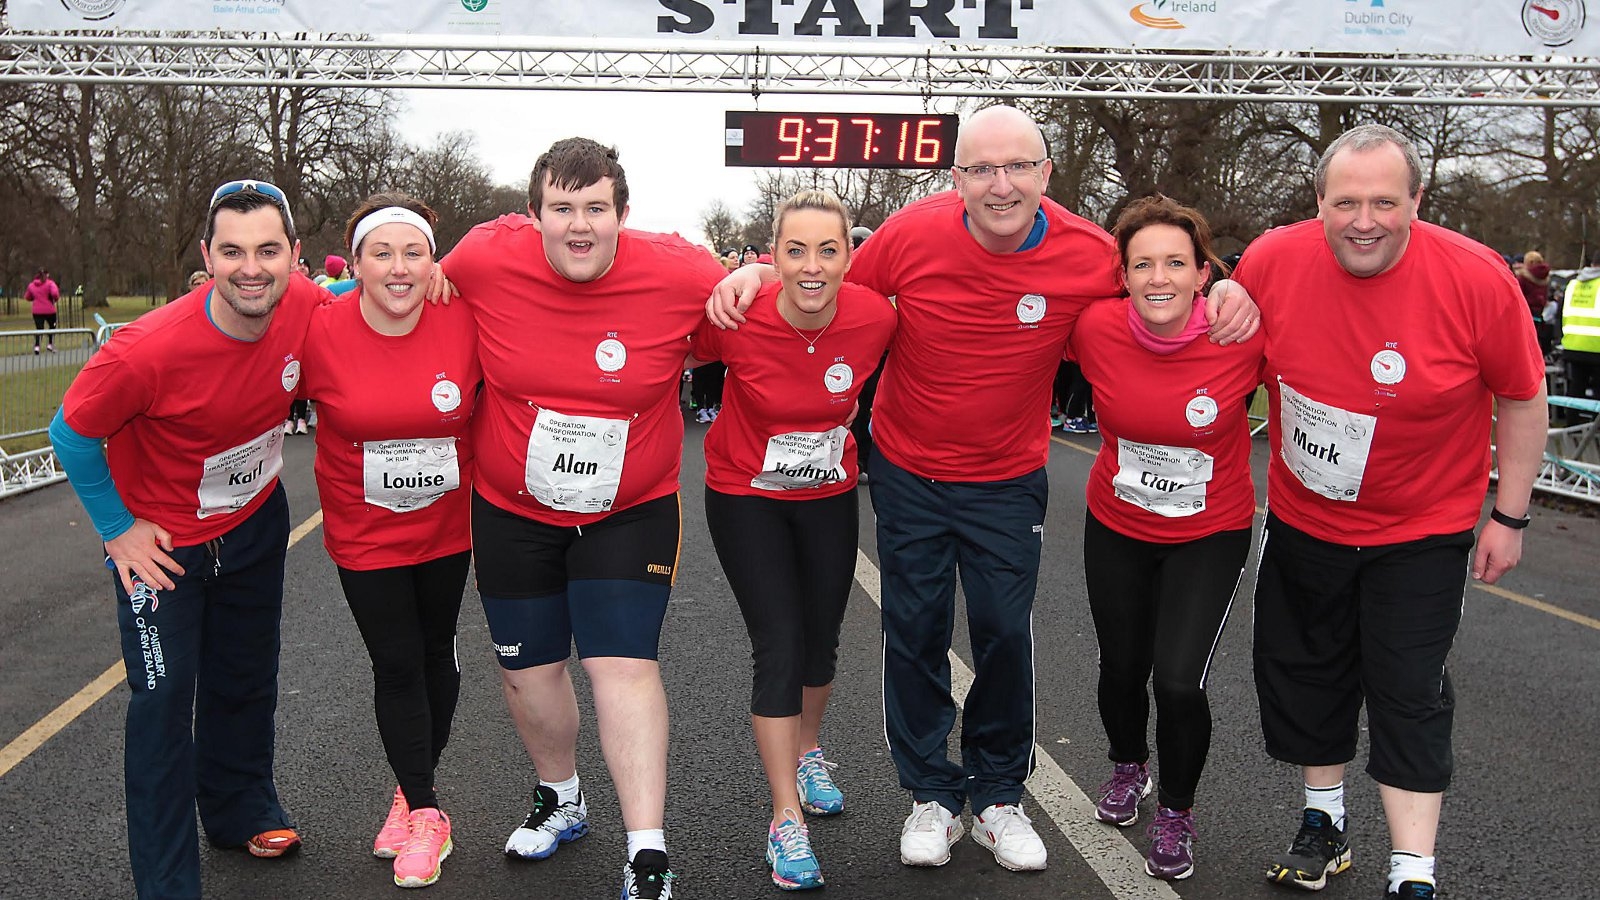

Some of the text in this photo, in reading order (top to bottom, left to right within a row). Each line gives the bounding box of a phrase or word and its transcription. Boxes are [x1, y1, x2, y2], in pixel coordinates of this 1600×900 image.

[1172, 1, 1217, 13] Ireland
[657, 0, 1034, 39] START
[1345, 11, 1414, 27] Dublin City
[778, 118, 942, 163] 9:37:16
[1283, 395, 1338, 428] TRANSFORMATION
[1291, 396, 1327, 417] OPERATION
[538, 423, 596, 438] TRANSFORMATION
[549, 419, 586, 429] OPERATION
[1303, 417, 1316, 427] RUN
[784, 434, 821, 443] OPERATION
[1293, 426, 1341, 466] Mark
[218, 445, 254, 462] OPERATION
[1122, 445, 1181, 464] TRANSFORMATION
[233, 460, 247, 469] RUN
[552, 453, 598, 476] Alan
[1147, 459, 1162, 467] RUN
[228, 460, 263, 486] Karl
[383, 472, 445, 489] Louise
[136, 616, 156, 690] OF NEW ZEALAND
[148, 625, 166, 677] CANTERBURY
